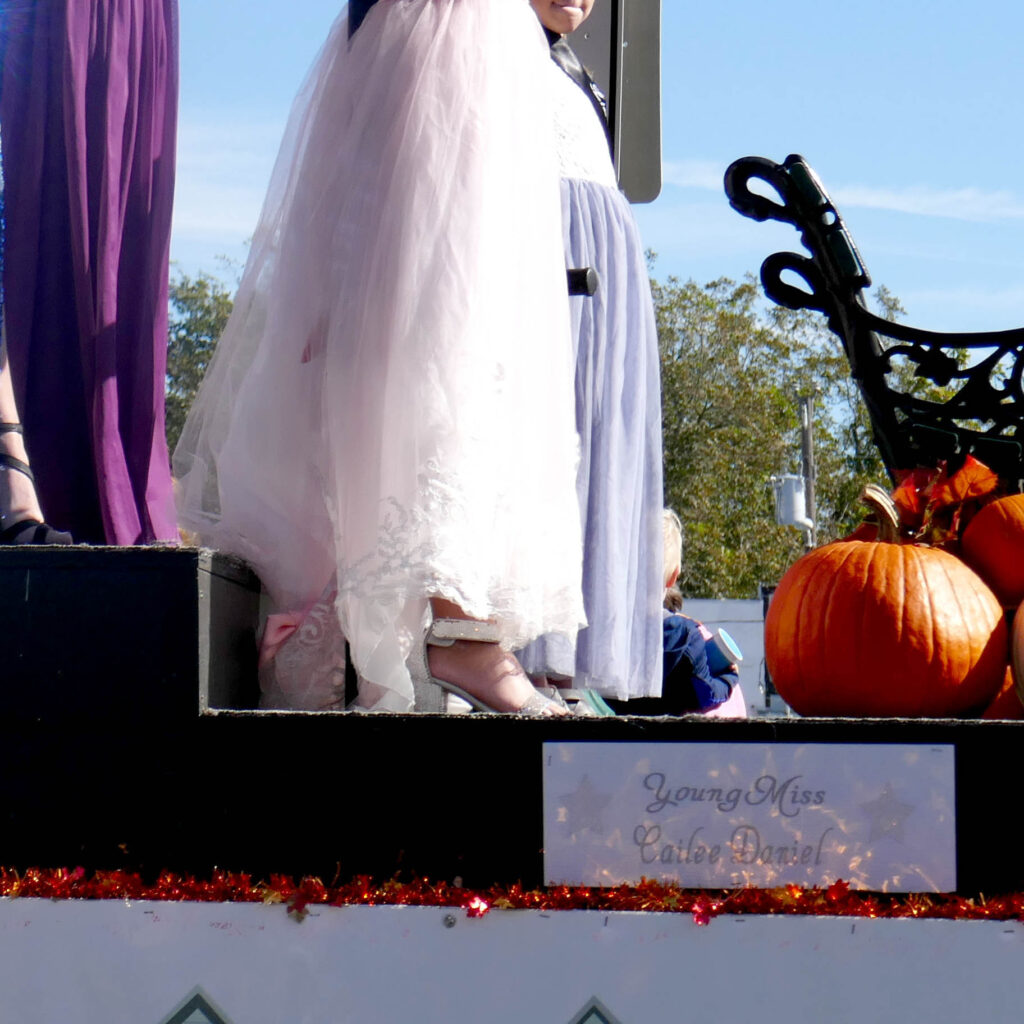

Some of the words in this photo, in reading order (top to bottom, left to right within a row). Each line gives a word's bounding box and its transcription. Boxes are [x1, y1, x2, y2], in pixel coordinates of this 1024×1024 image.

[642, 772, 742, 813] Young
[745, 774, 826, 818] Miss
[633, 824, 721, 865] Cailee
[730, 824, 835, 866] Daniel
